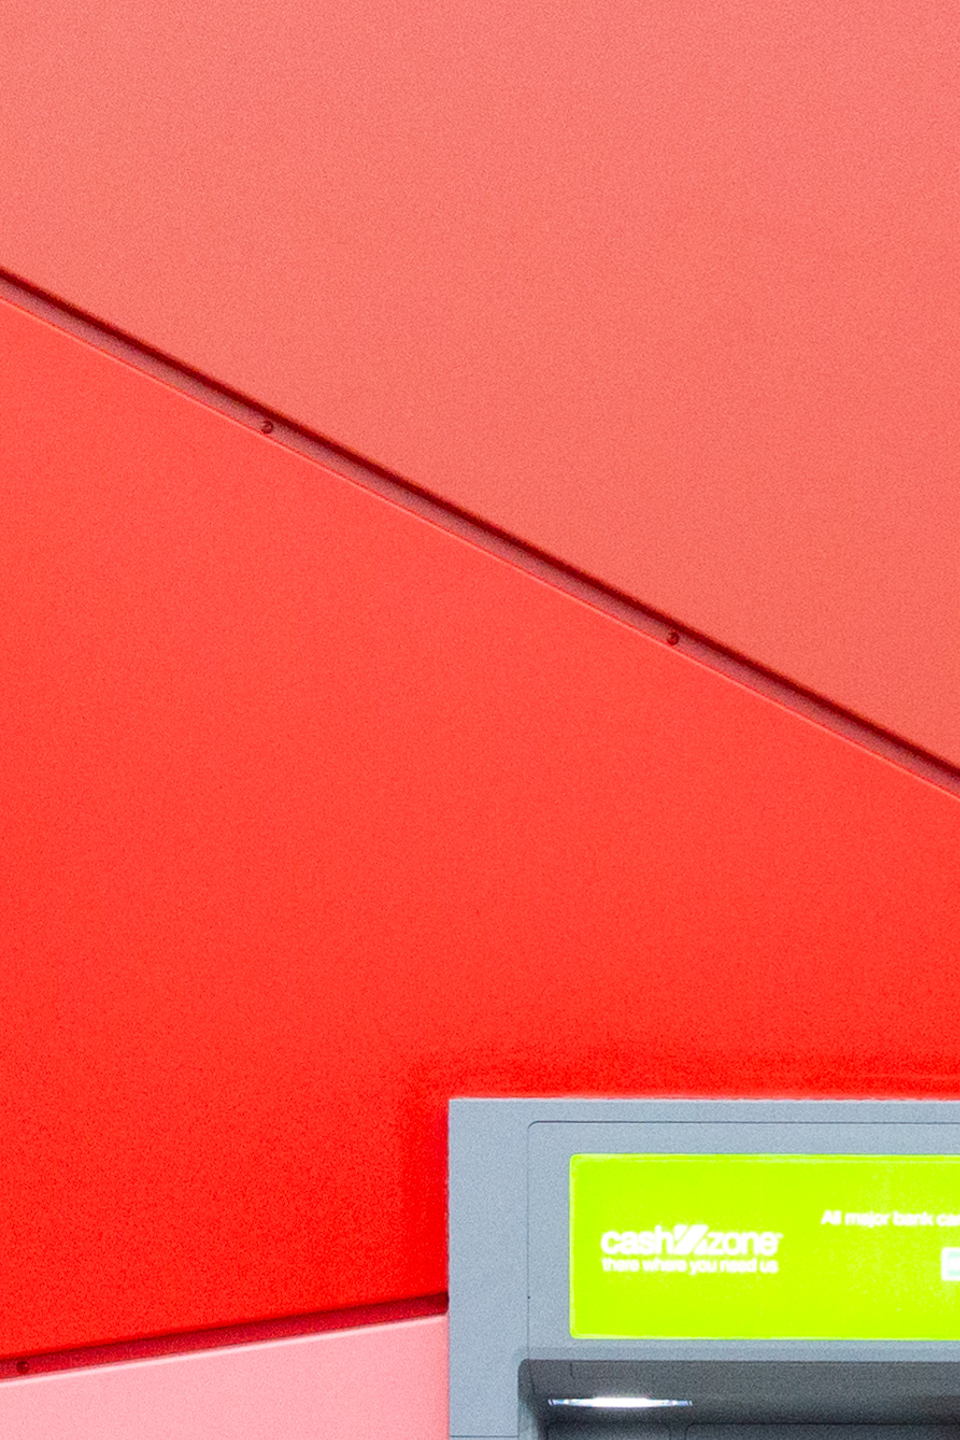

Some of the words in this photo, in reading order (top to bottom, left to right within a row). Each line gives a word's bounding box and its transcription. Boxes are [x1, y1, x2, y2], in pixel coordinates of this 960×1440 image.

[820, 1210, 842, 1226] All
[844, 1211, 890, 1228] major
[892, 1210, 934, 1226] bank
[688, 1259, 718, 1276] you
[720, 1257, 758, 1274] need
[759, 1259, 780, 1274] us
